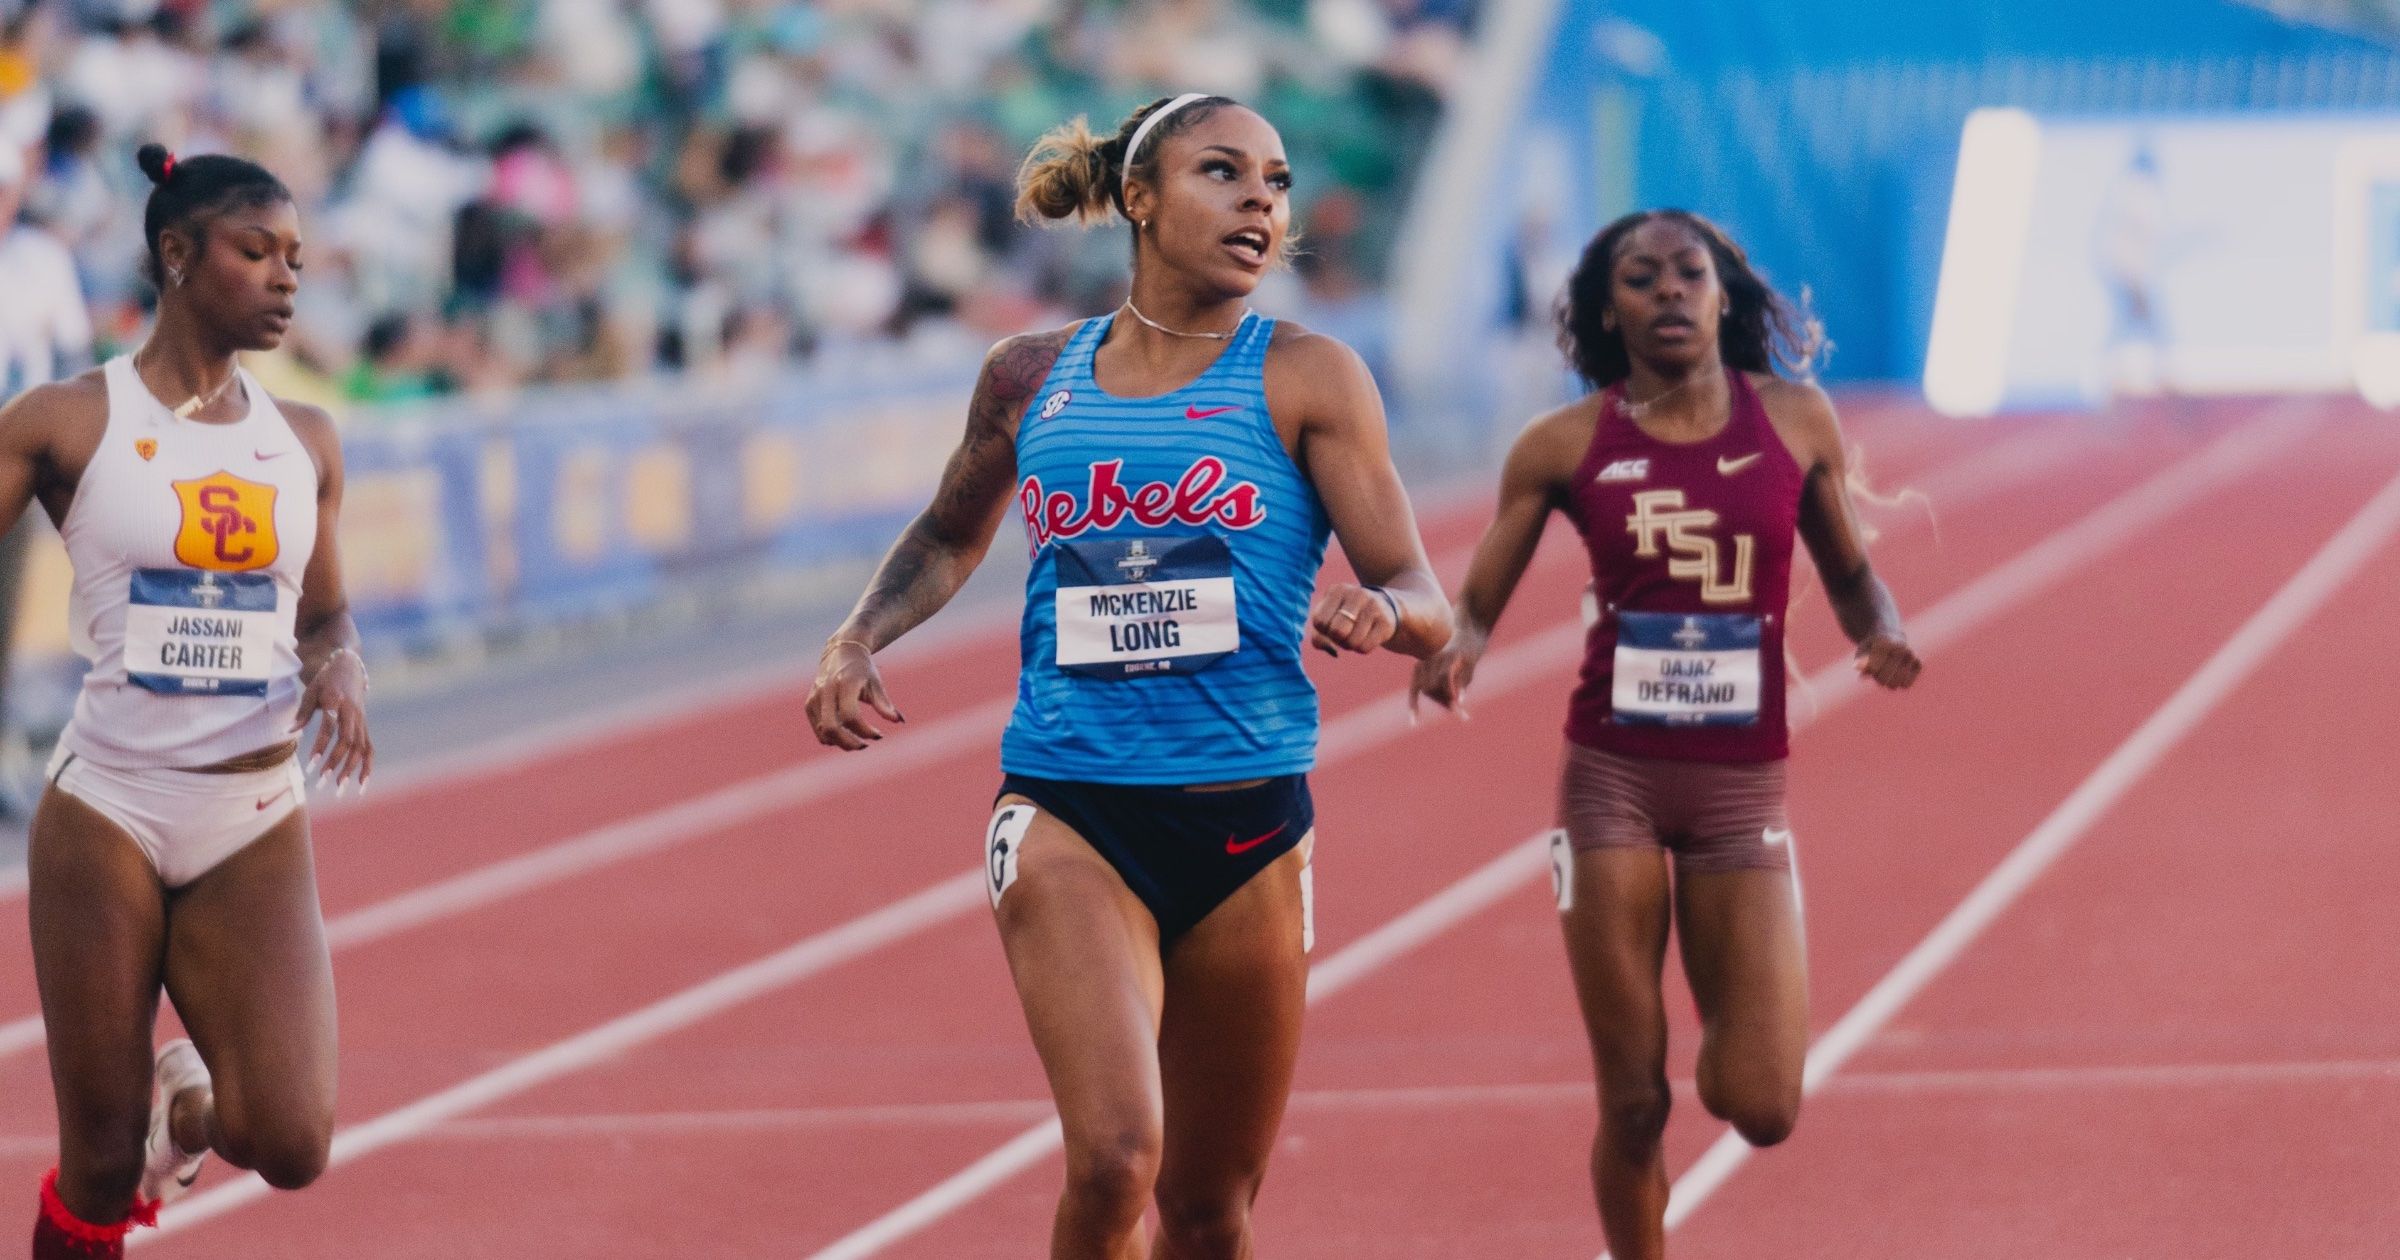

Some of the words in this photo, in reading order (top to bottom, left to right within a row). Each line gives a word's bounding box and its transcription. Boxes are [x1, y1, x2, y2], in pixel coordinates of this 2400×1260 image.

[1596, 458, 1649, 483] ACC
[1020, 455, 1267, 560] Rebels
[199, 485, 257, 562] SC
[1626, 489, 1753, 603] FSU
[1090, 589, 1197, 616] MCKENZIE
[167, 616, 243, 638] JASSANI
[1110, 620, 1180, 652] LONG
[161, 641, 243, 669] CARTER
[1660, 657, 1716, 677] DAJAZ
[1638, 680, 1735, 704] DEFRAND
[991, 810, 1015, 892] 6
